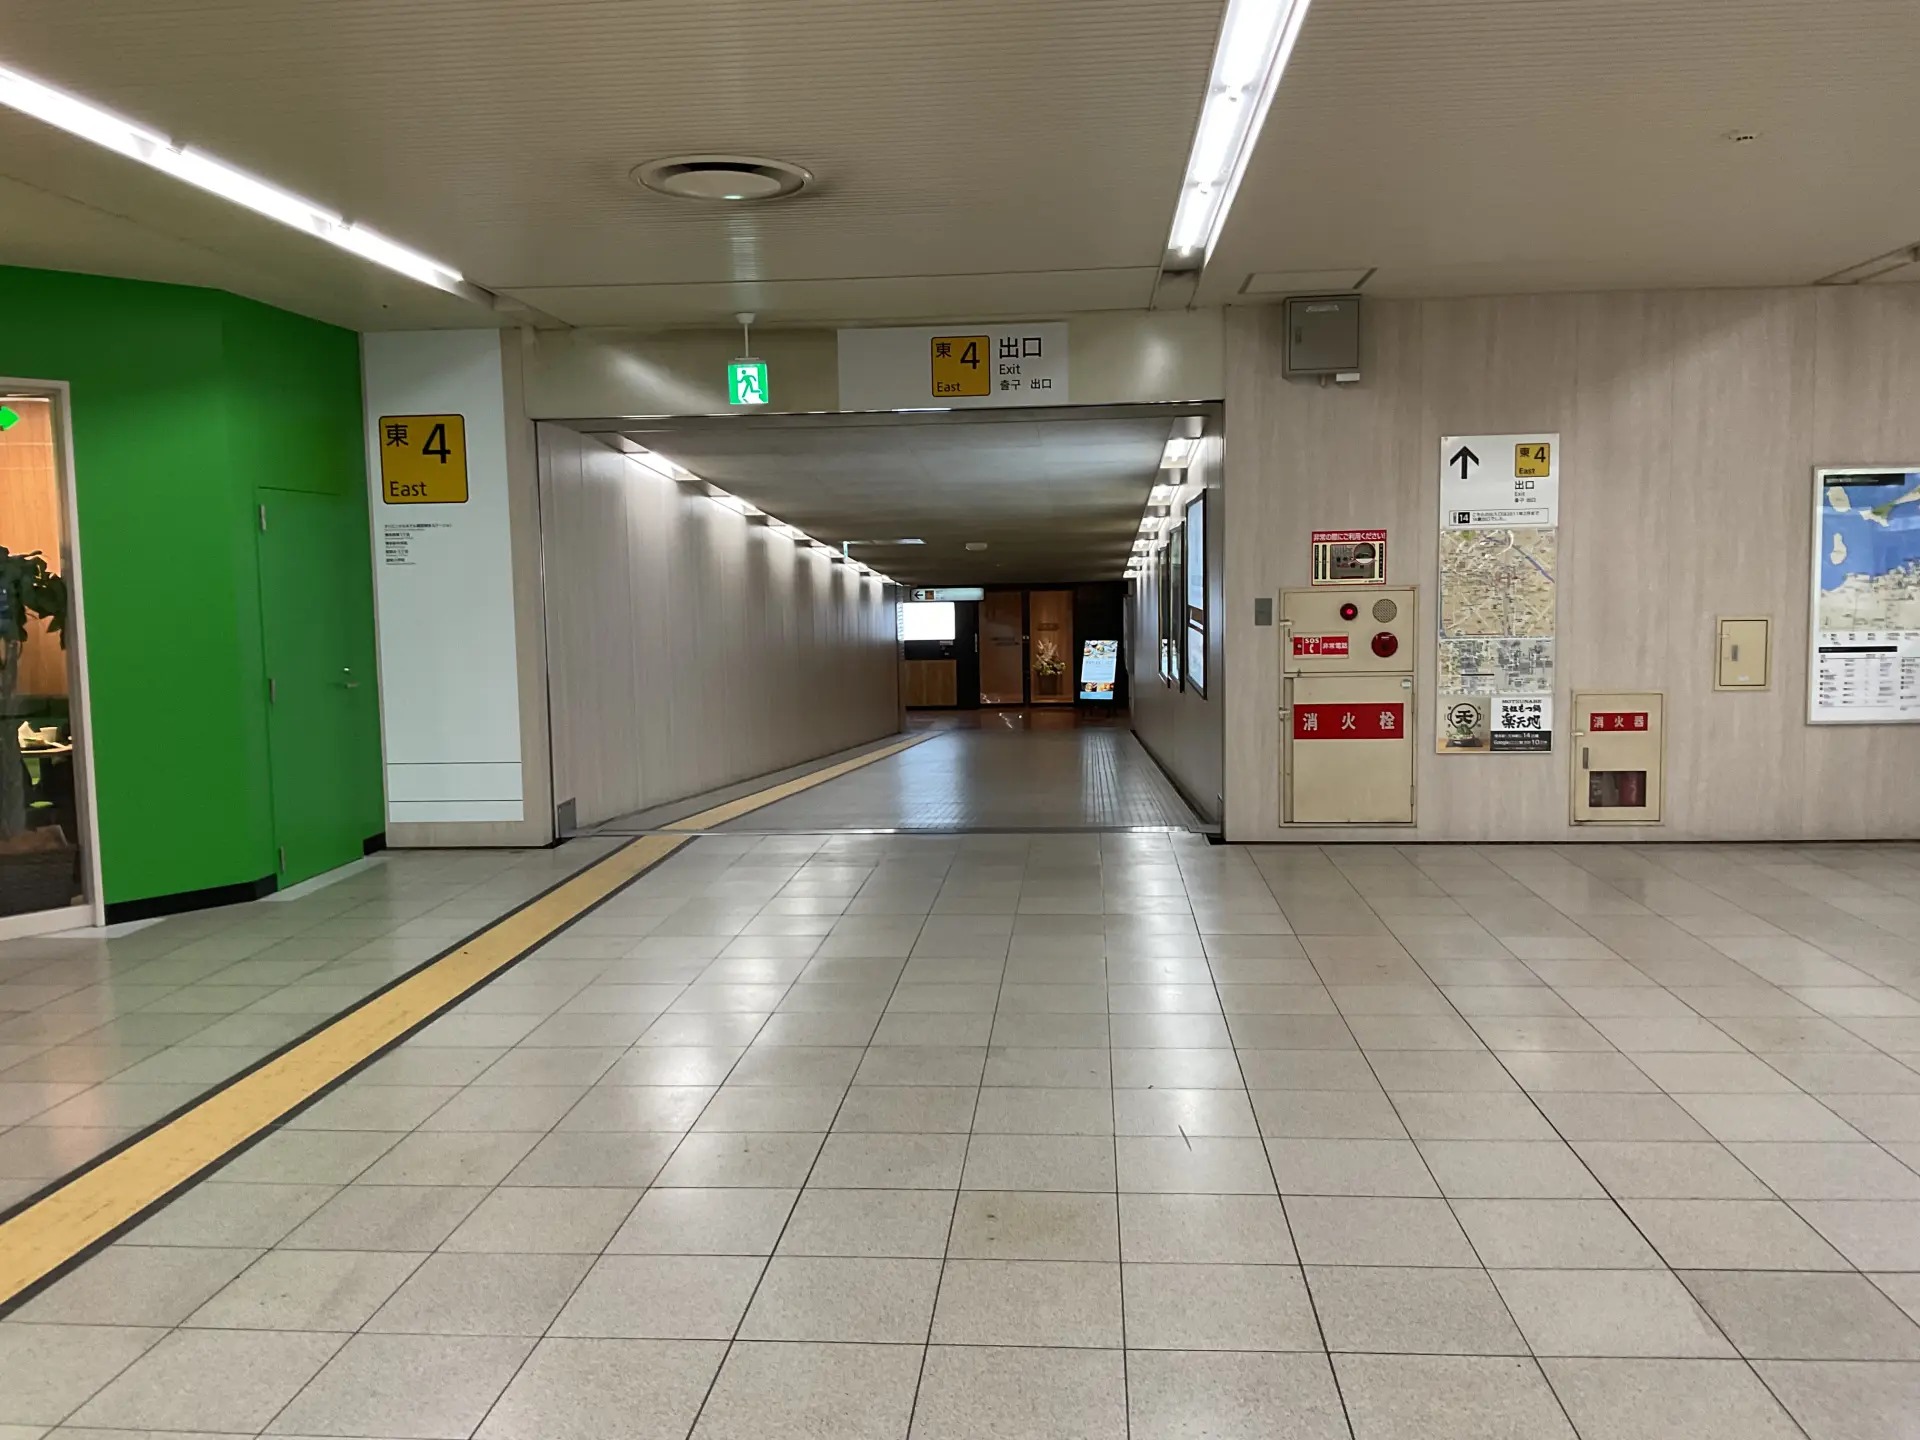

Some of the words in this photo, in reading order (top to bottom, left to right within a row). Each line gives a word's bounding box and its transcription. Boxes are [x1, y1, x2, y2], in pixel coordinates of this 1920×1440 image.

[935, 342, 952, 358] 東
[960, 341, 980, 370] 4
[999, 336, 1042, 360] 出口
[999, 364, 1021, 376] Exit
[937, 381, 961, 393] East
[1000, 380, 1021, 391] 출구
[1030, 378, 1052, 390] 出口
[384, 423, 409, 447] 東
[422, 423, 452, 465] 4
[1519, 447, 1531, 458] 東
[1533, 446, 1546, 463] 4
[1519, 467, 1536, 475] East
[390, 480, 428, 497] East
[1514, 480, 1535, 490] 出口
[1459, 513, 1469, 522] 14
[1302, 711, 1396, 732] 消火栓
[1501, 712, 1542, 729] 楽天地
[1592, 715, 1645, 729] 消火器
